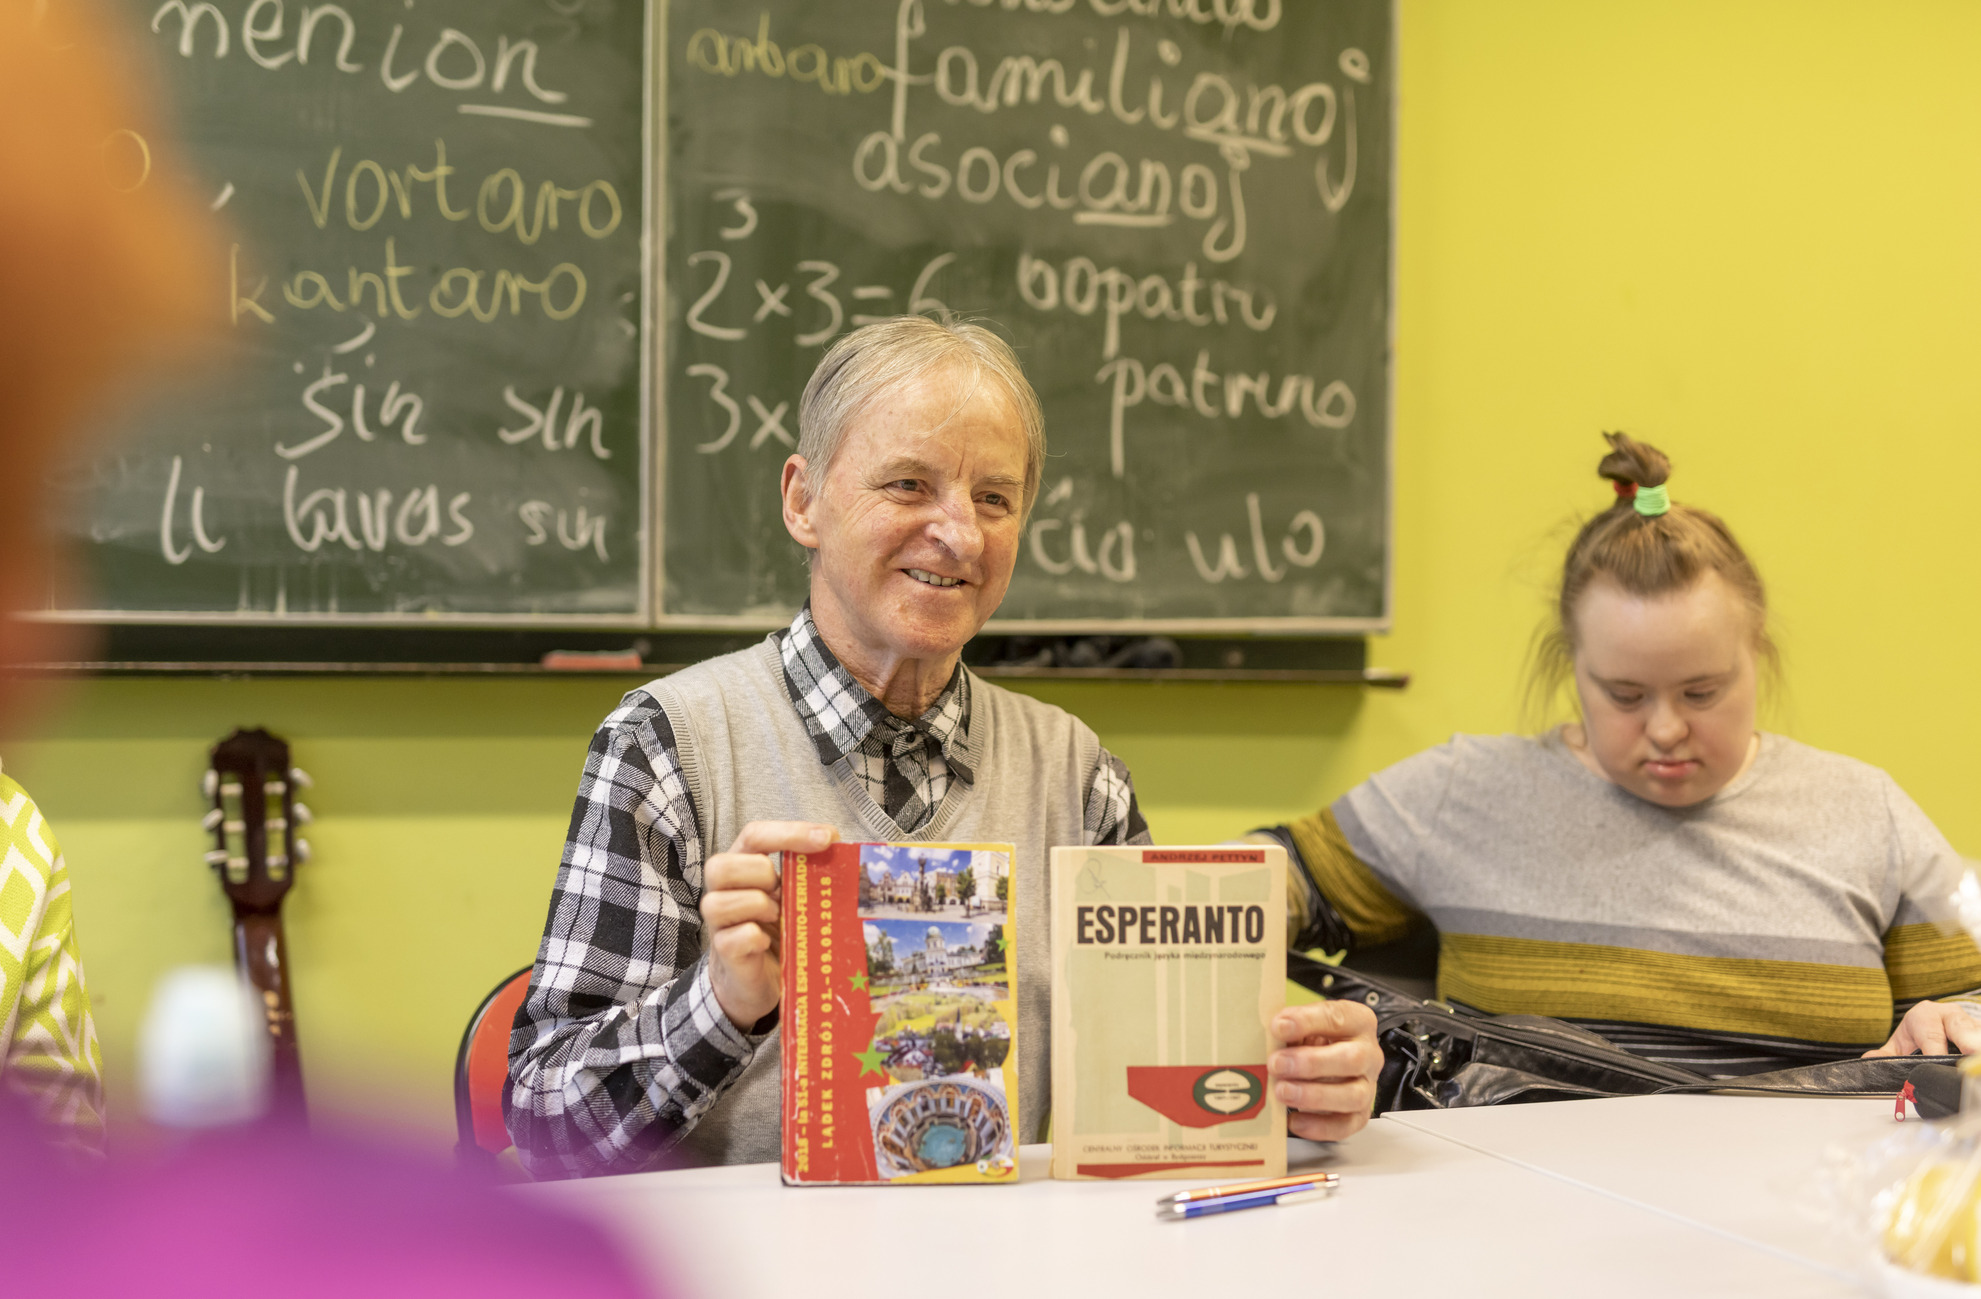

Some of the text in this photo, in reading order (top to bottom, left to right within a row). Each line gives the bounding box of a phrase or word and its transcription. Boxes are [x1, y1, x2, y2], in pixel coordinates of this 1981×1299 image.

[297, 138, 623, 245] vortaro
[853, 131, 1249, 263] asocianoj
[230, 236, 588, 327] kantaro
[1185, 492, 1326, 584] ulo
[1150, 853, 1208, 862] ANDRZEJ
[1077, 905, 1264, 945] ESPERANTO
[796, 995, 809, 1076] INTERNACIA
[819, 1021, 834, 1081] ZDRÓJ
